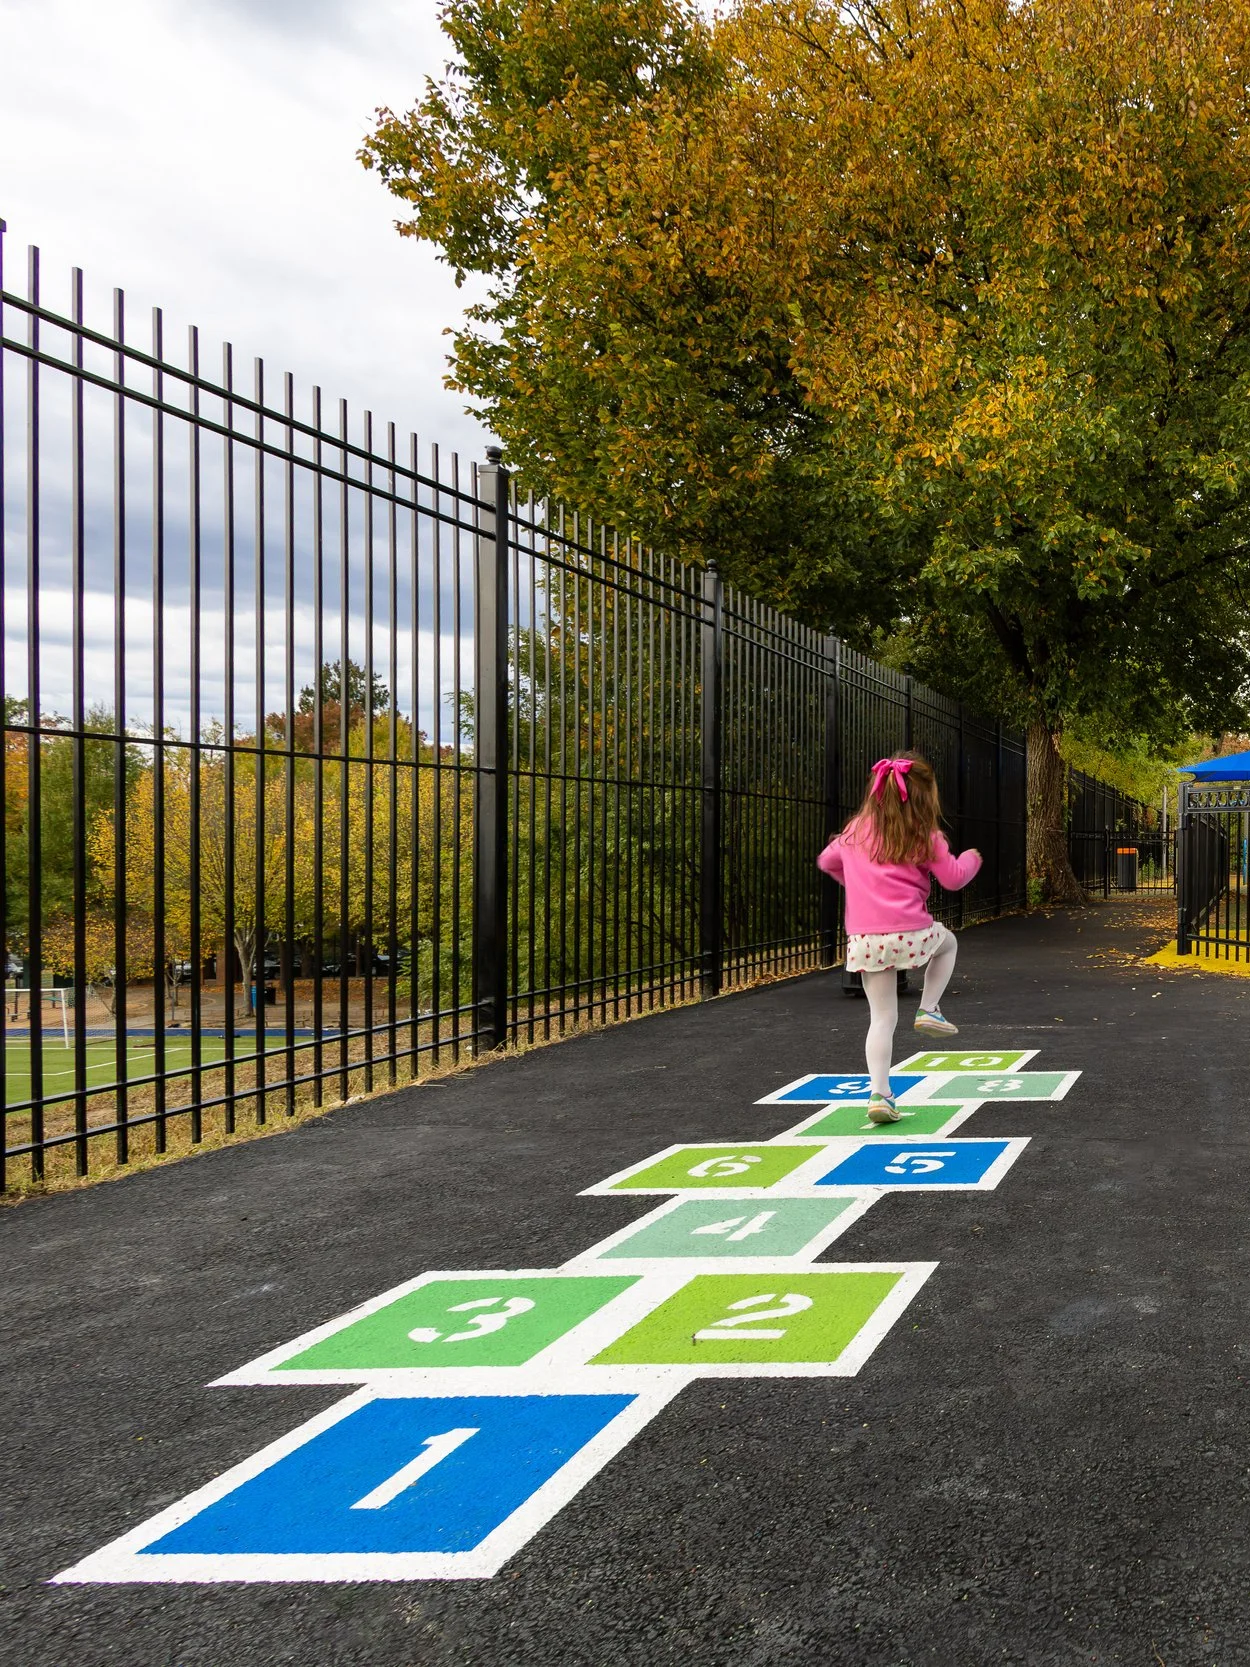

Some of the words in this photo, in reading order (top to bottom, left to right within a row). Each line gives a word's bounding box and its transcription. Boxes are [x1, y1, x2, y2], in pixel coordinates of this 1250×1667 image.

[925, 1056, 1003, 1068] 10
[828, 1081, 873, 1095] 9
[976, 1079, 1024, 1093] 8
[687, 1155, 762, 1178] 6
[884, 1151, 957, 1174] 5
[690, 1211, 778, 1241] 4
[407, 1297, 537, 1344] 3
[693, 1293, 814, 1341] 2
[349, 1427, 481, 1510] 1
